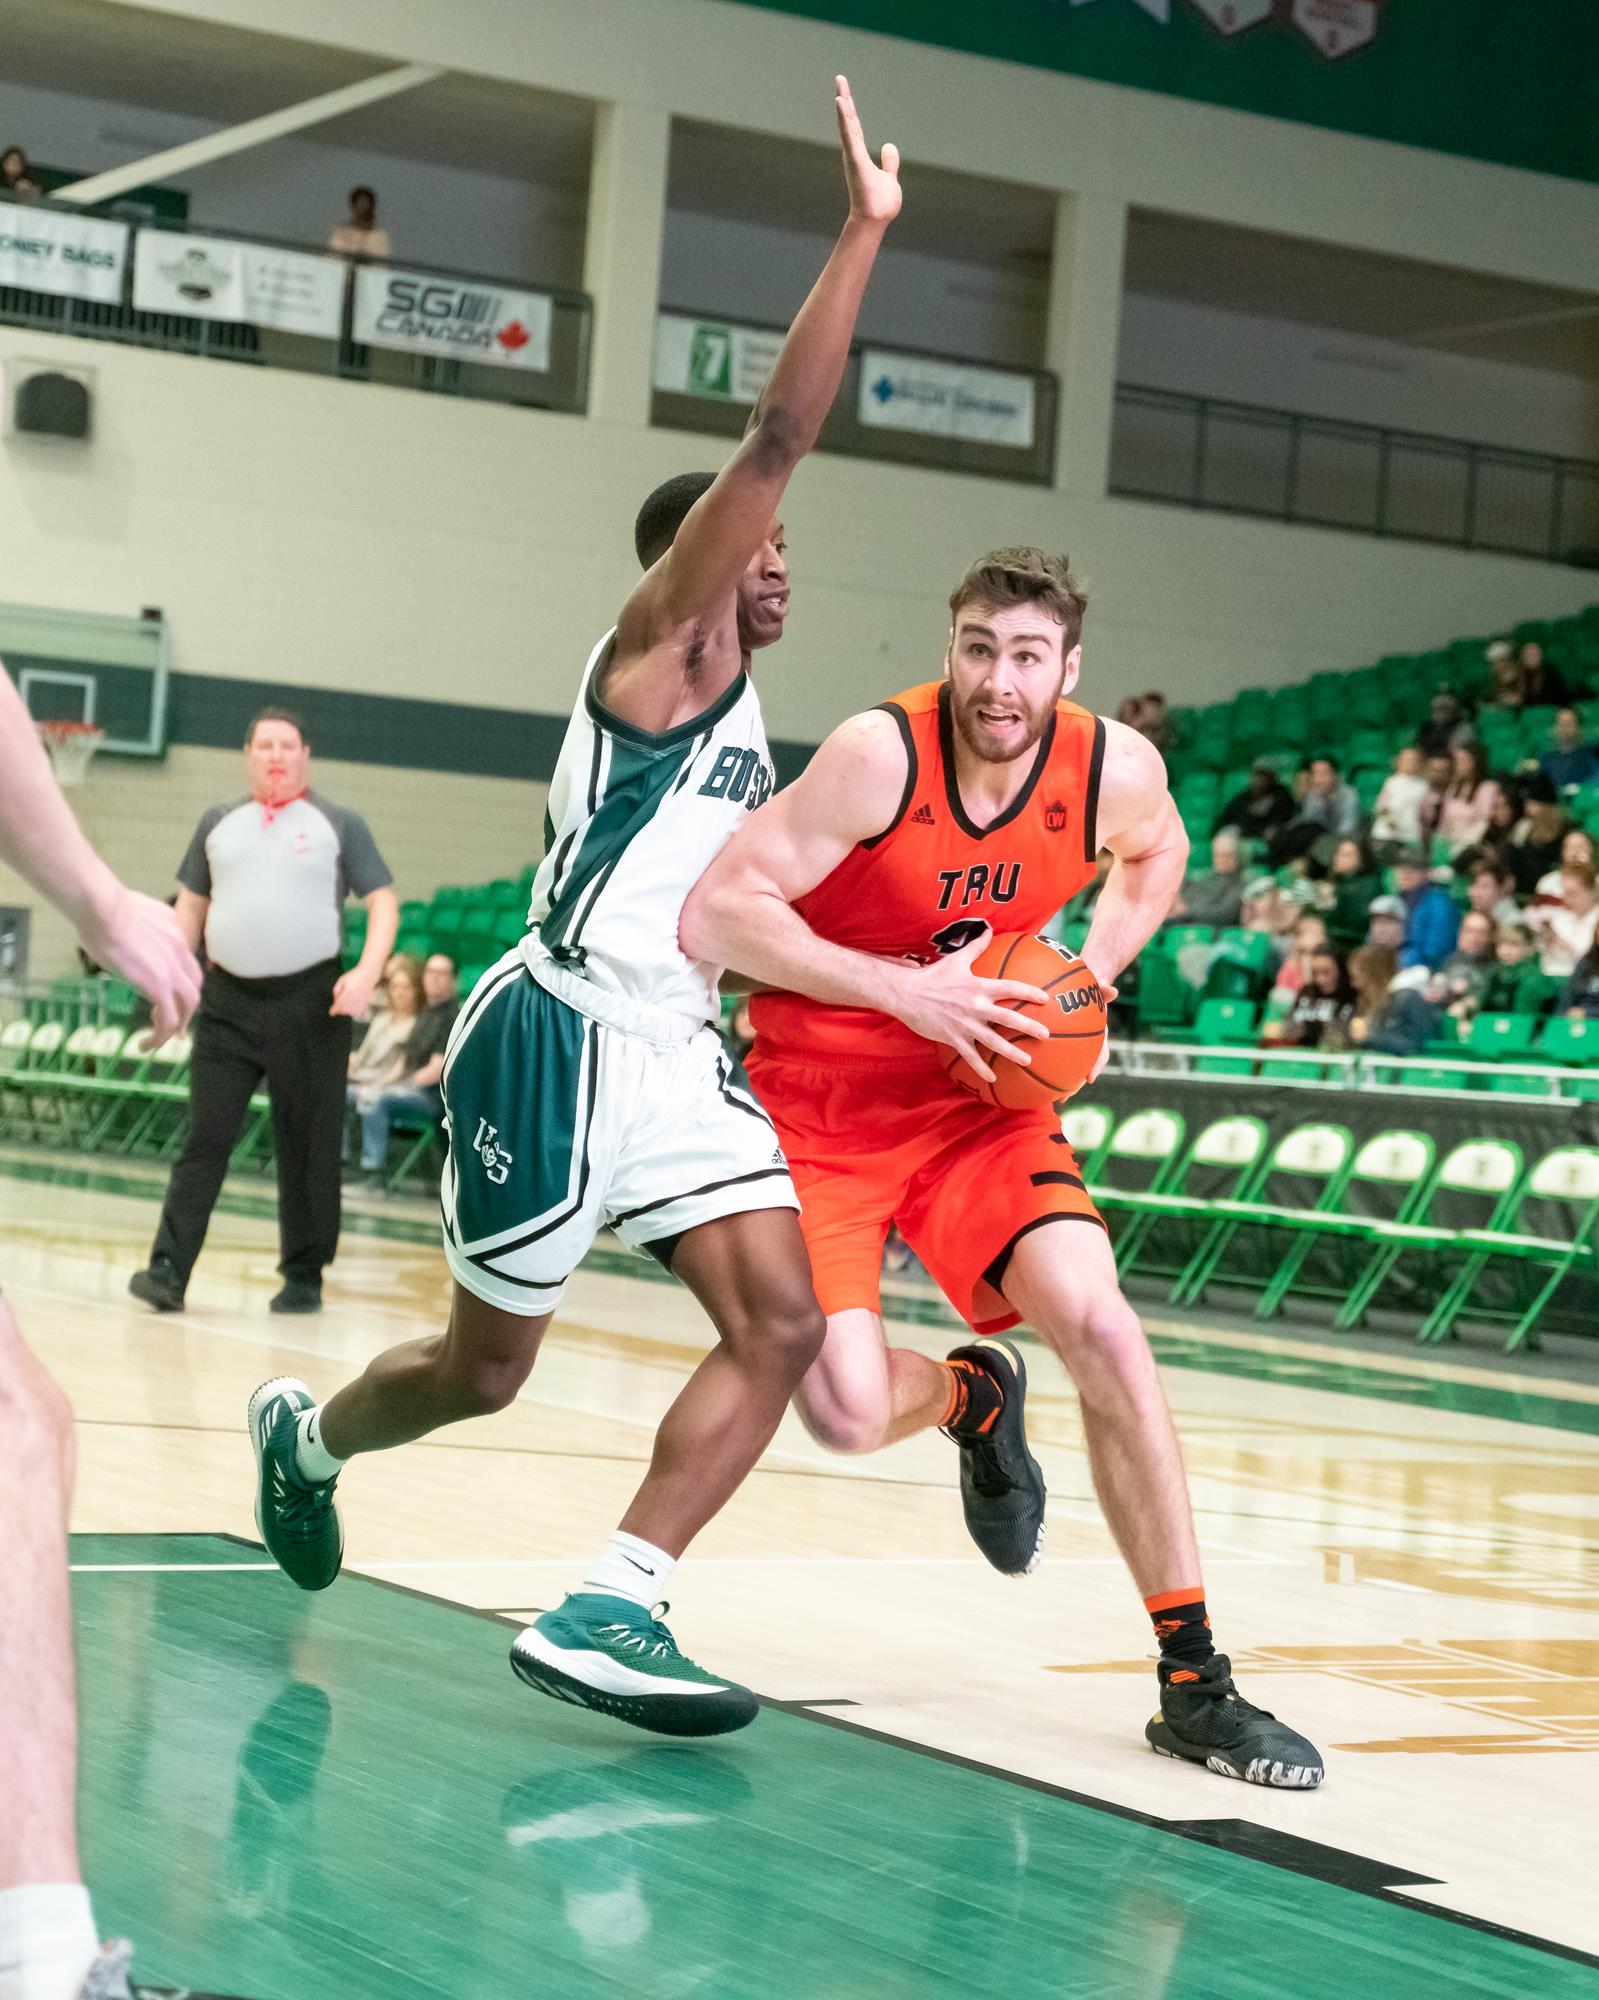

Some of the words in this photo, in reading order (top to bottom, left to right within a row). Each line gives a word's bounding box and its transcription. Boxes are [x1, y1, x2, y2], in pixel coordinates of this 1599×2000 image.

[62, 244, 115, 269] BAGS
[386, 279, 470, 318] SGI
[376, 313, 491, 347] CANADA
[936, 861, 1023, 911] TRU
